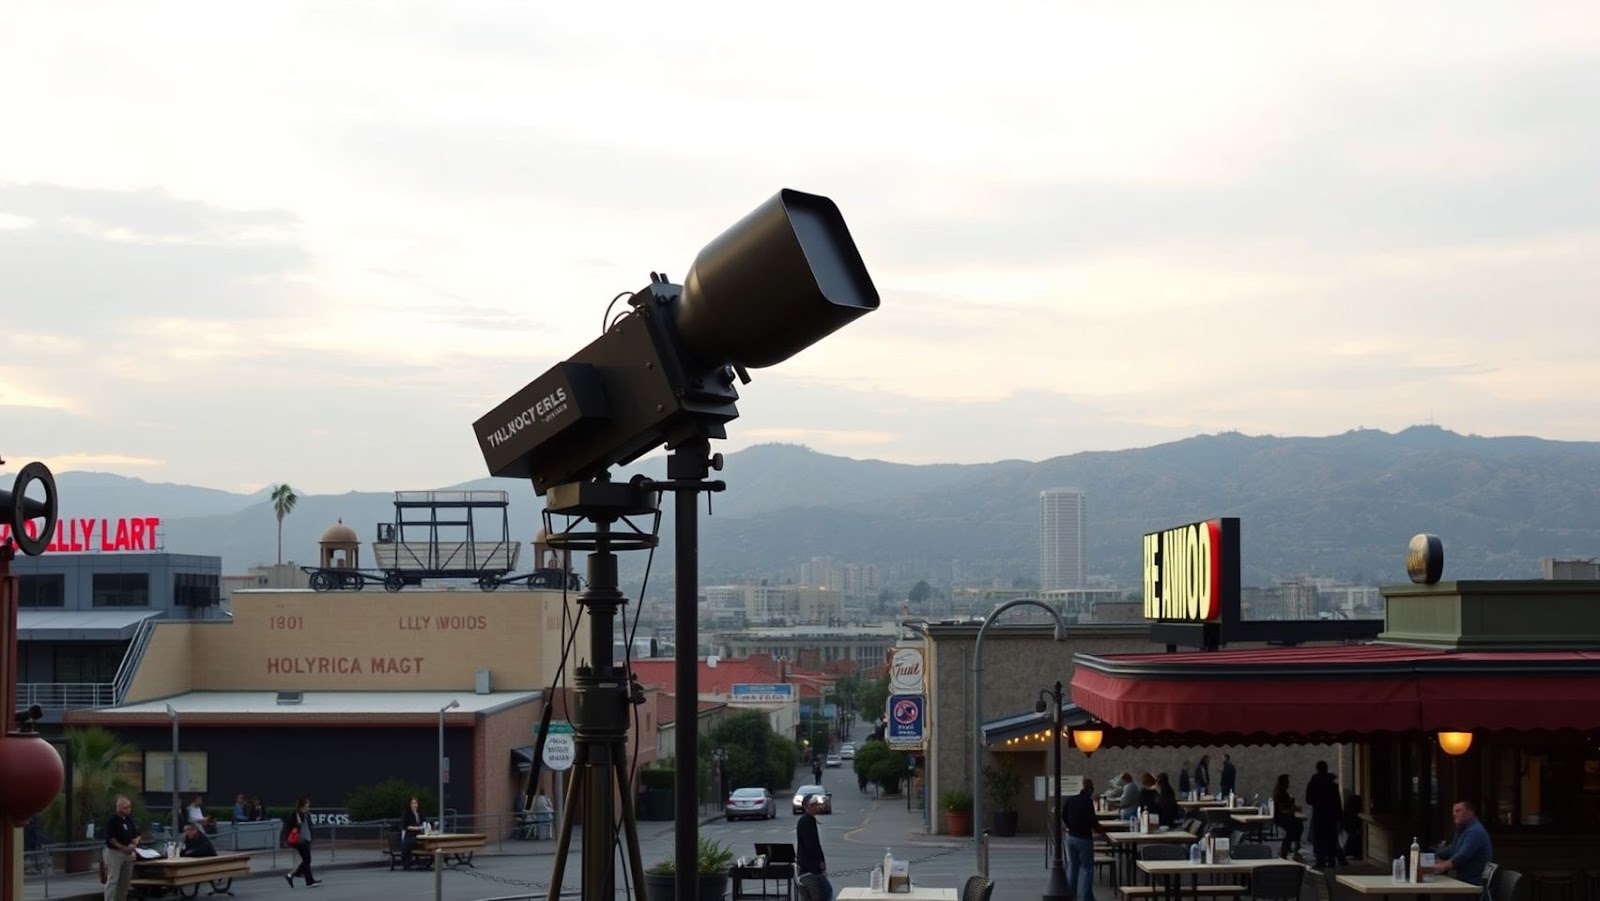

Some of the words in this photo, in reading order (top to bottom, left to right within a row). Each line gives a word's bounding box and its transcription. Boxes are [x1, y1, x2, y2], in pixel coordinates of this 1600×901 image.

[101, 518, 159, 551] LART
[267, 657, 363, 674] HOLYRICA
[370, 657, 425, 674] MAGT
